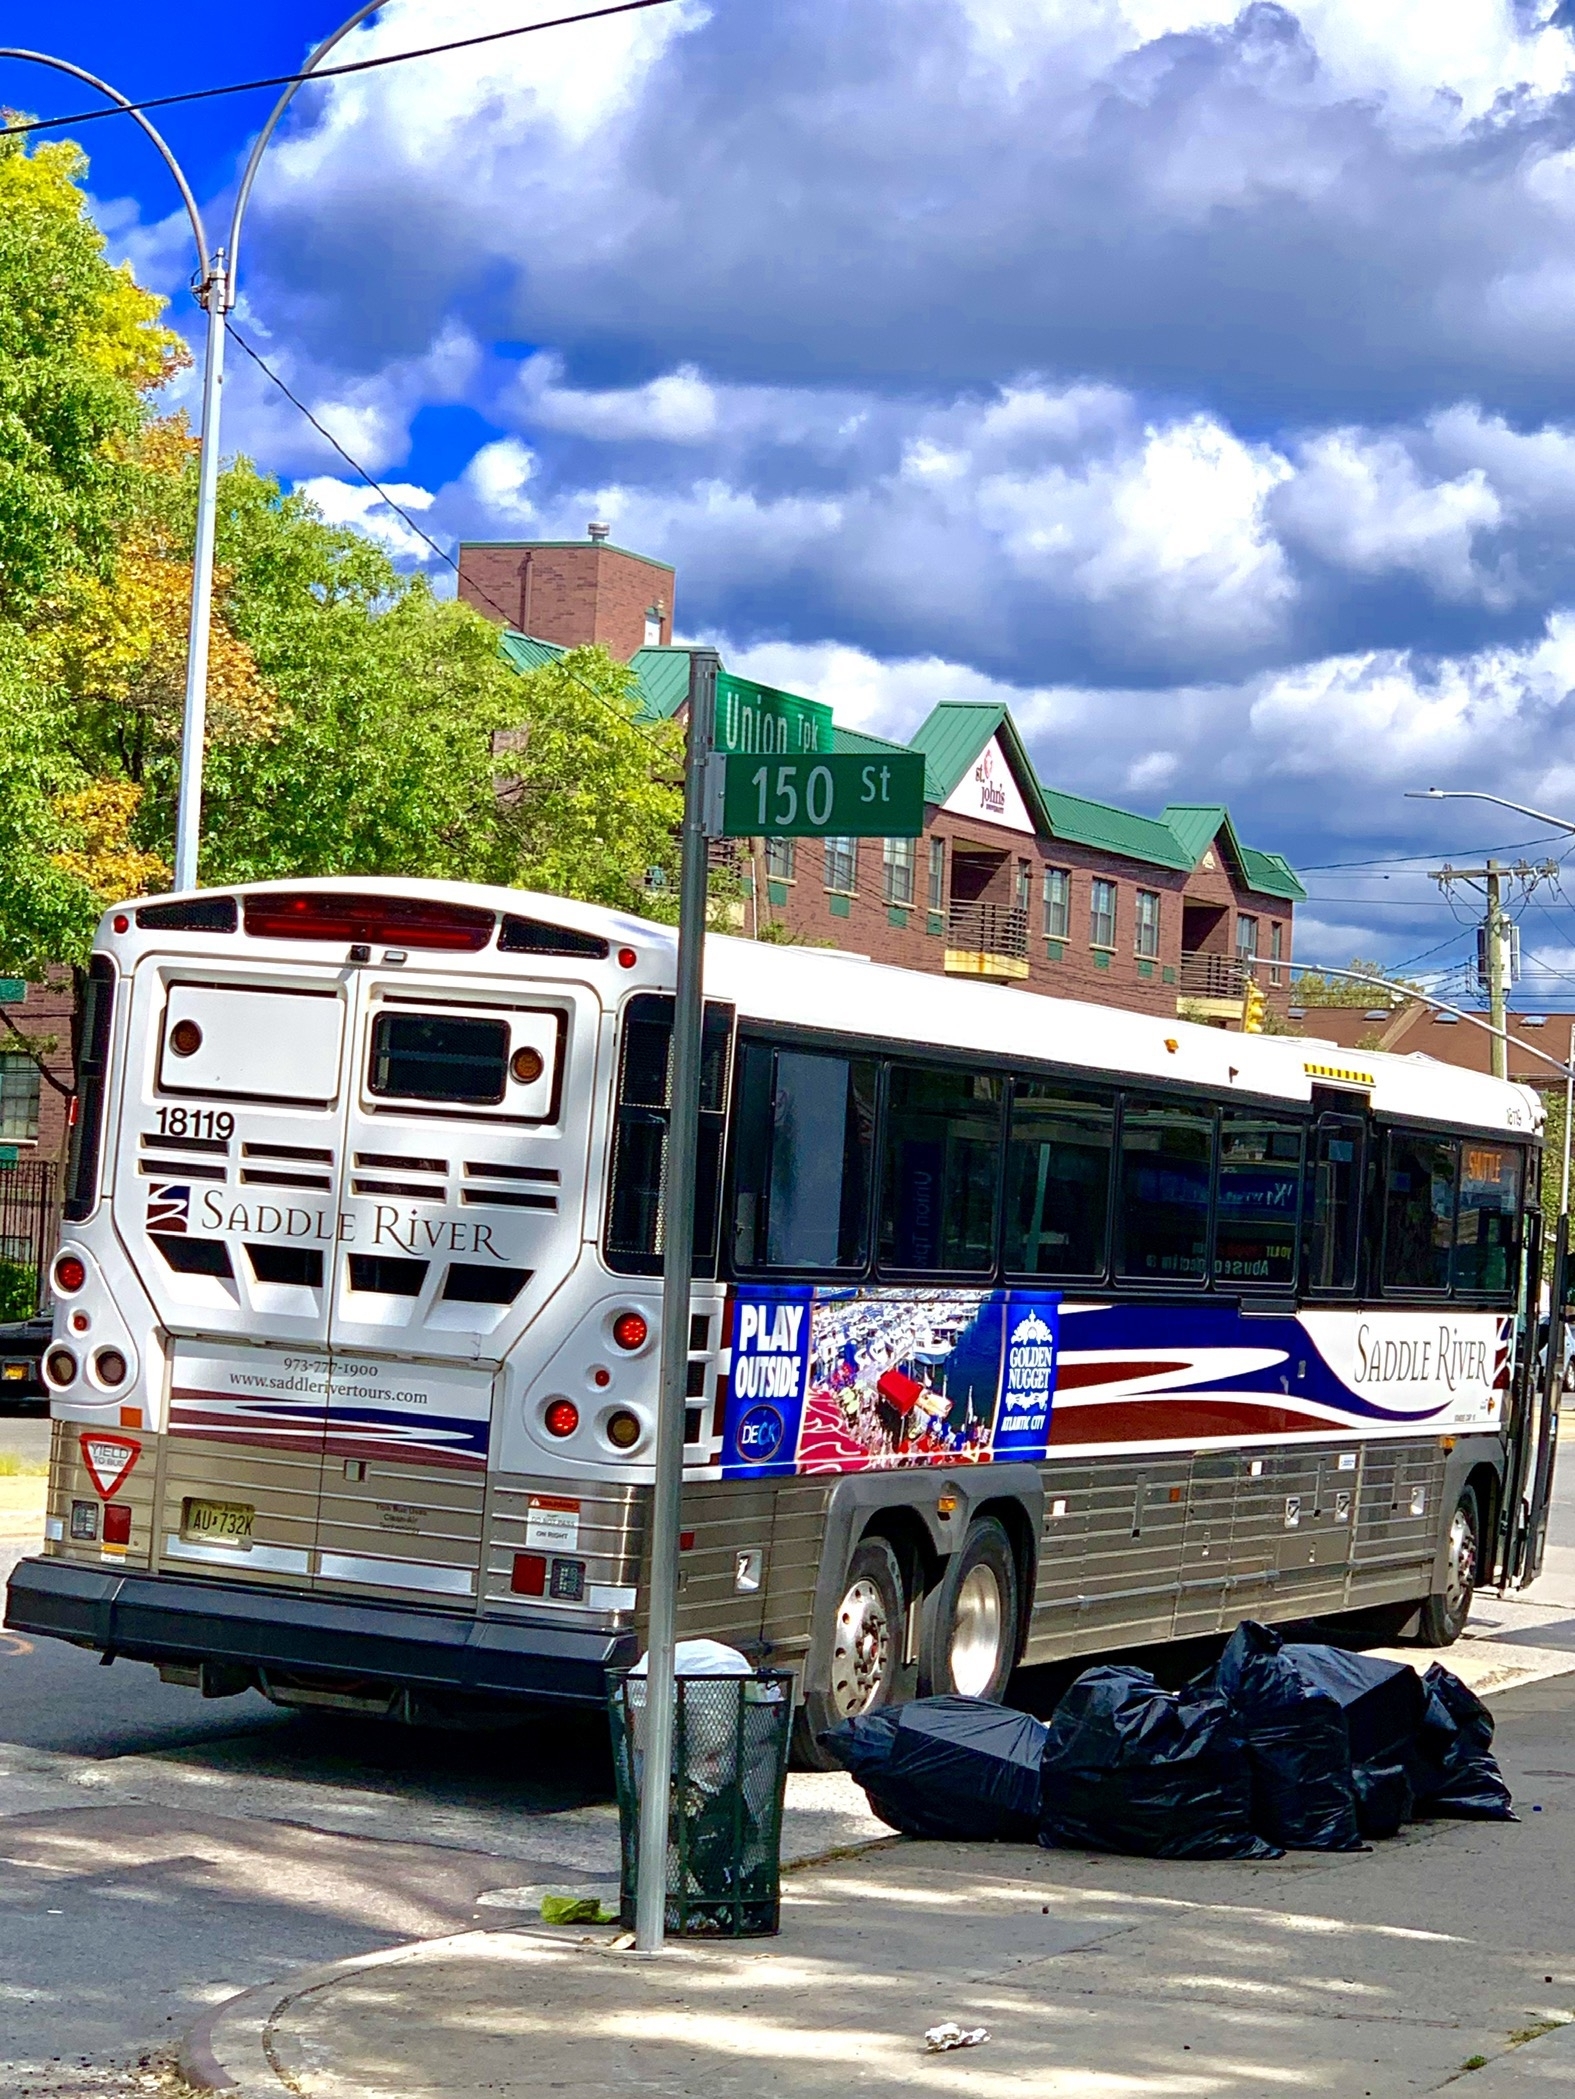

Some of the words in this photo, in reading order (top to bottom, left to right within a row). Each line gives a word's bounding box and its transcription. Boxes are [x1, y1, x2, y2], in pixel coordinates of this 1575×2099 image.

[726, 691, 788, 753] Union
[797, 713, 819, 752] Tpk
[752, 765, 834, 826] 150
[860, 765, 891, 802] St
[980, 780, 1006, 808] john's
[155, 1107, 235, 1141] 18119
[201, 1189, 357, 1243] SADDLE
[738, 1304, 805, 1352] PLAY
[283, 1357, 379, 1378] 973-777-1900
[1009, 1346, 1054, 1368] GOLDEN
[1354, 1323, 1432, 1384] SADDLE
[229, 1373, 429, 1404] www.saddlerivertours.com
[734, 1355, 802, 1399] OUTSIDE
[1007, 1367, 1052, 1390] NUGGET
[741, 1421, 779, 1446] DECK
[1000, 1415, 1032, 1432] ATLANTIC
[1030, 1414, 1046, 1430] CITY
[91, 1443, 129, 1460] YIELD
[94, 1455, 106, 1466] TO
[107, 1457, 125, 1468] BUS
[536, 1530, 547, 1538] ON
[548, 1531, 569, 1540] RIGHT
